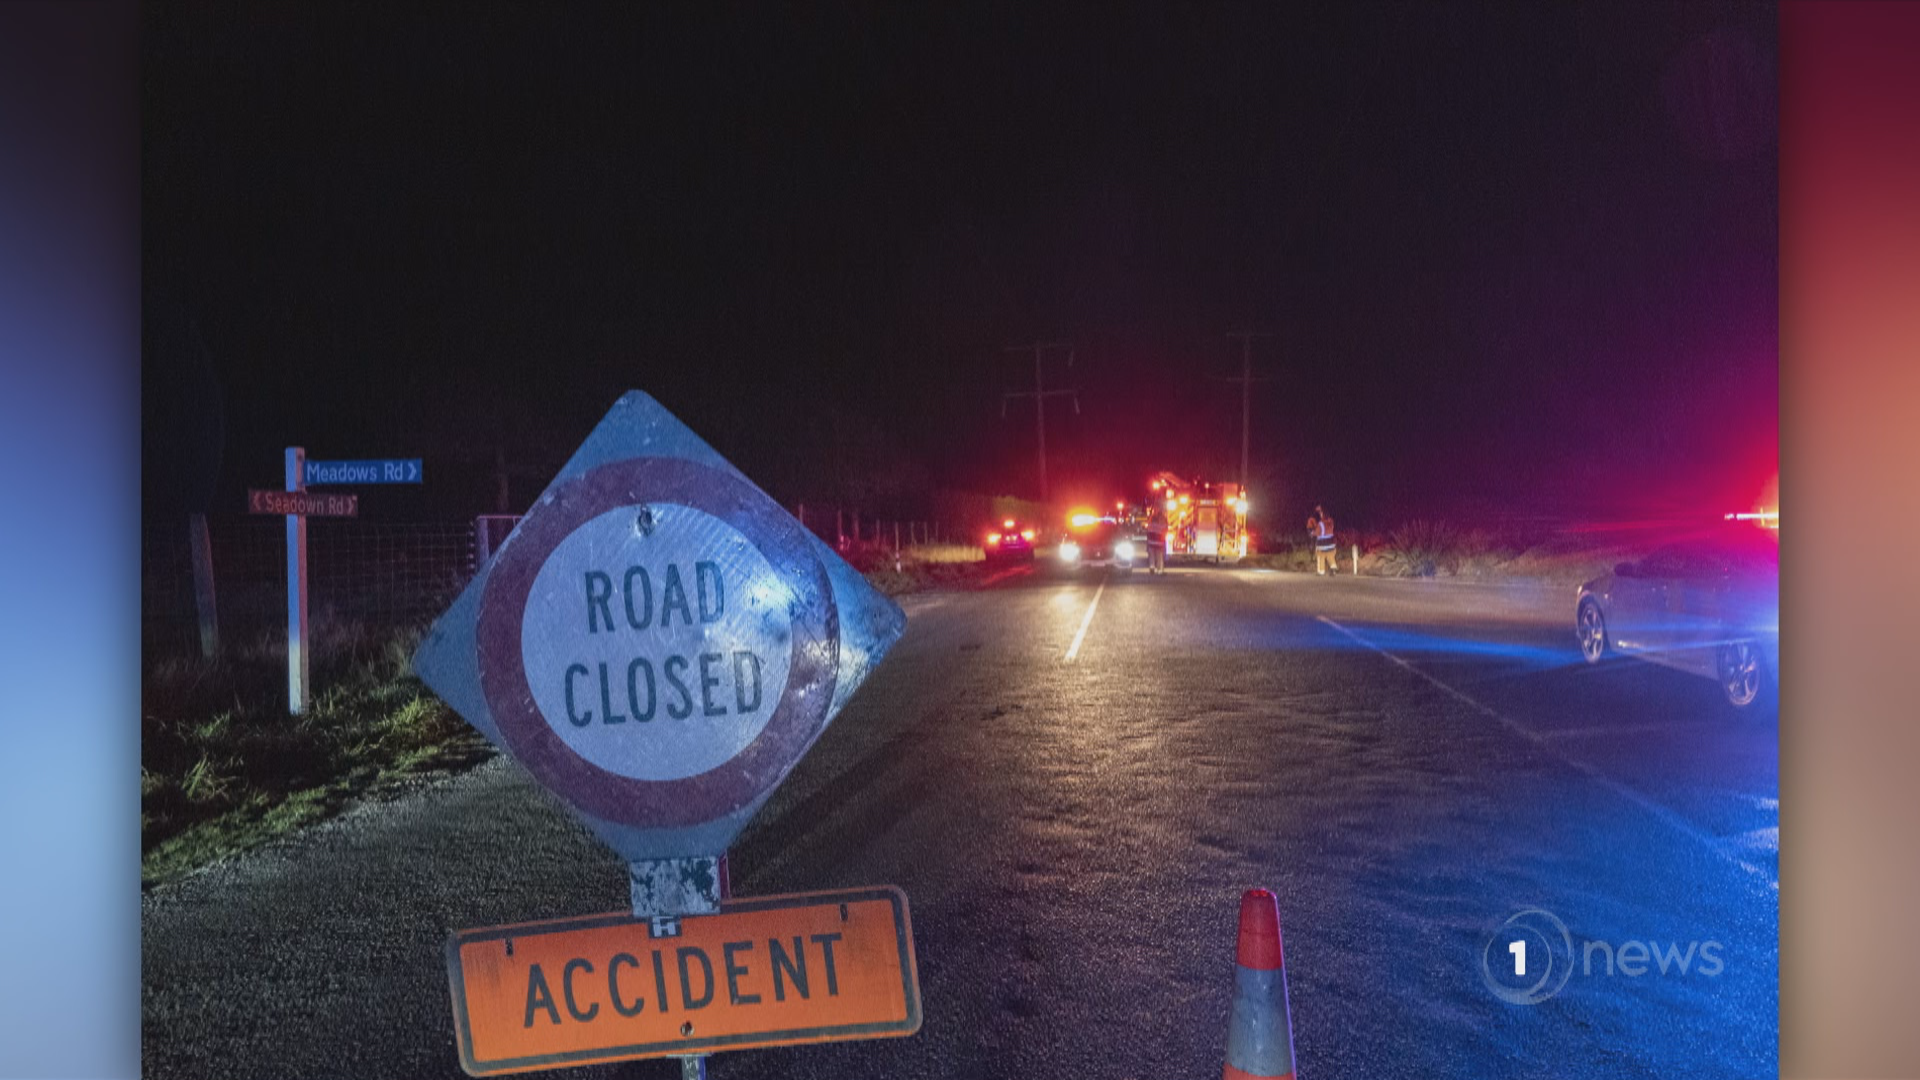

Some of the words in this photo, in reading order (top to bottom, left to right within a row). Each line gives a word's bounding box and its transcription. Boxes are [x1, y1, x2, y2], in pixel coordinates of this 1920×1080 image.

[265, 493, 325, 514] Seadown
[328, 496, 344, 514] Rd
[306, 463, 377, 481] Meadows
[384, 463, 403, 480] Rd
[584, 560, 725, 634] ROAD
[564, 650, 762, 728] CLOSED
[523, 932, 843, 1028] ACCIDENT
